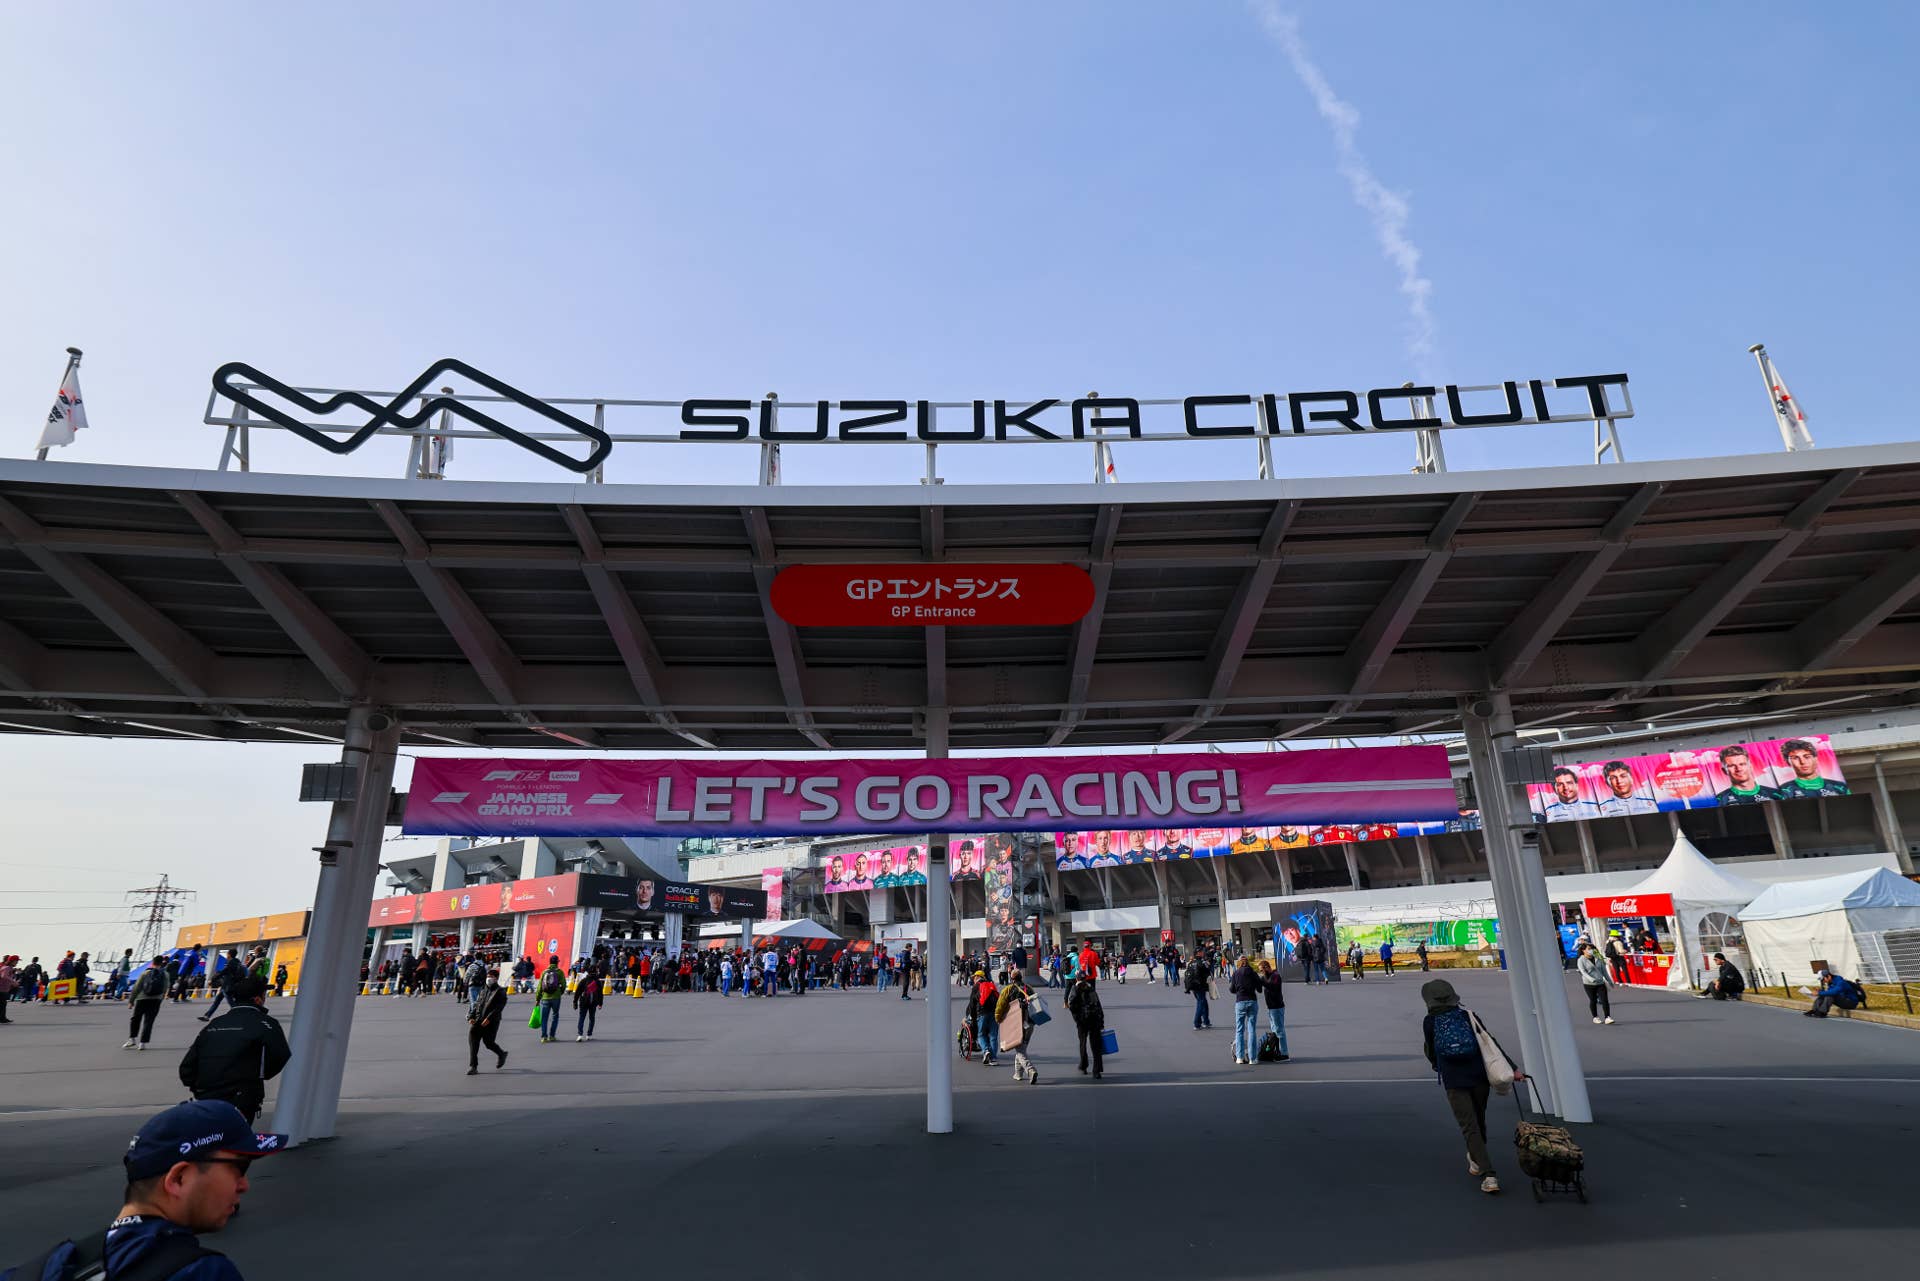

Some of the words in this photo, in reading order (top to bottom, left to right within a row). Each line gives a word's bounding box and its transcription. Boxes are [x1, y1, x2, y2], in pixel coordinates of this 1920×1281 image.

[680, 398, 1142, 441] SUZUKA
[1184, 373, 1629, 437] CIRCUIT
[846, 577, 1021, 600] GPエントランス
[891, 606, 911, 617] GP
[915, 605, 976, 617] Entrance
[486, 792, 568, 804] JAPANESE
[655, 776, 839, 822] LET'S
[855, 775, 951, 821] GO
[967, 769, 1241, 819] RACING!
[477, 804, 533, 816] GRAND
[535, 805, 573, 817] PRIX
[665, 885, 700, 895] ORACLE
[192, 1132, 224, 1148] viaplay
